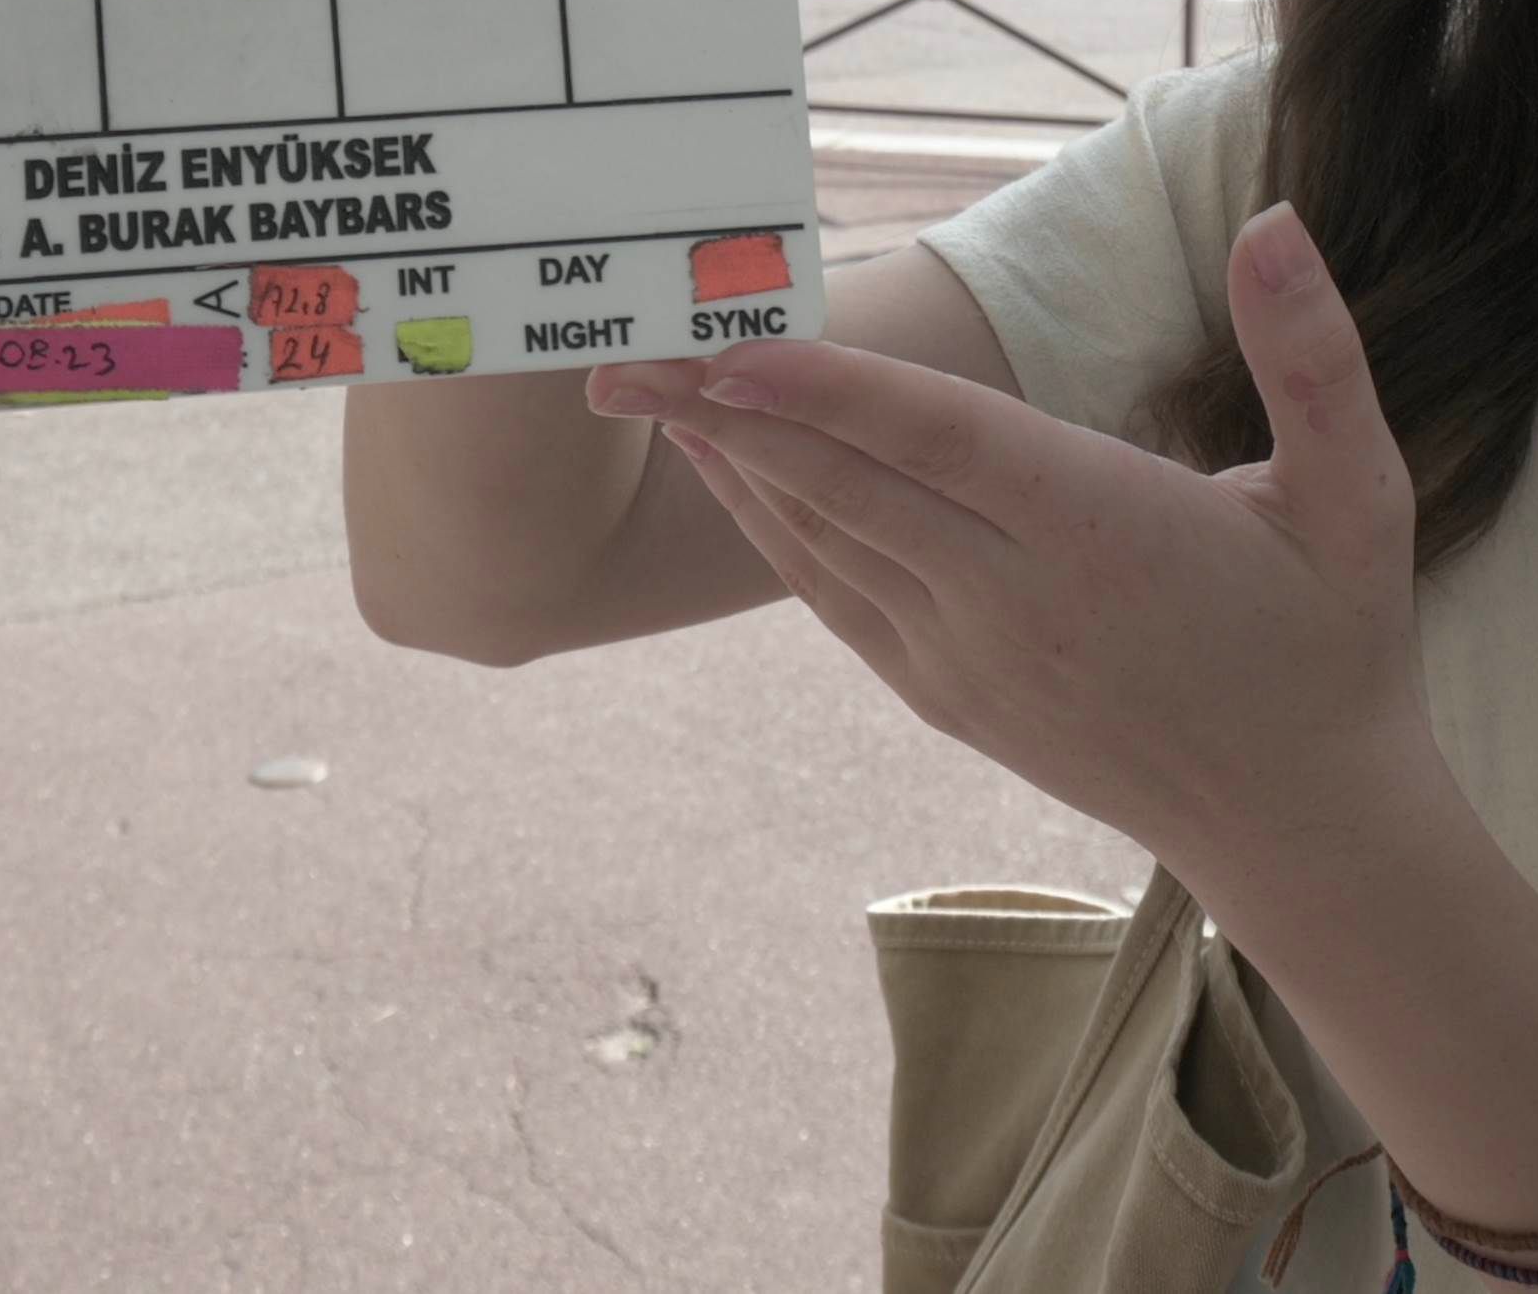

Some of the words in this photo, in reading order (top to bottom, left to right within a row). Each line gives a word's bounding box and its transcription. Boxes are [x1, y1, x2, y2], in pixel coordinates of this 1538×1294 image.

[24, 144, 167, 201] DENİZ
[181, 133, 437, 189] ENYÜKSEK
[20, 218, 64, 259] A.
[80, 205, 237, 255] BURAK
[250, 190, 453, 243] BAYBARS
[398, 265, 456, 296] INT
[539, 254, 610, 286] DAY
[524, 317, 635, 353] NIGHT
[692, 307, 788, 342] SYNC
[277, 335, 331, 373] 24
